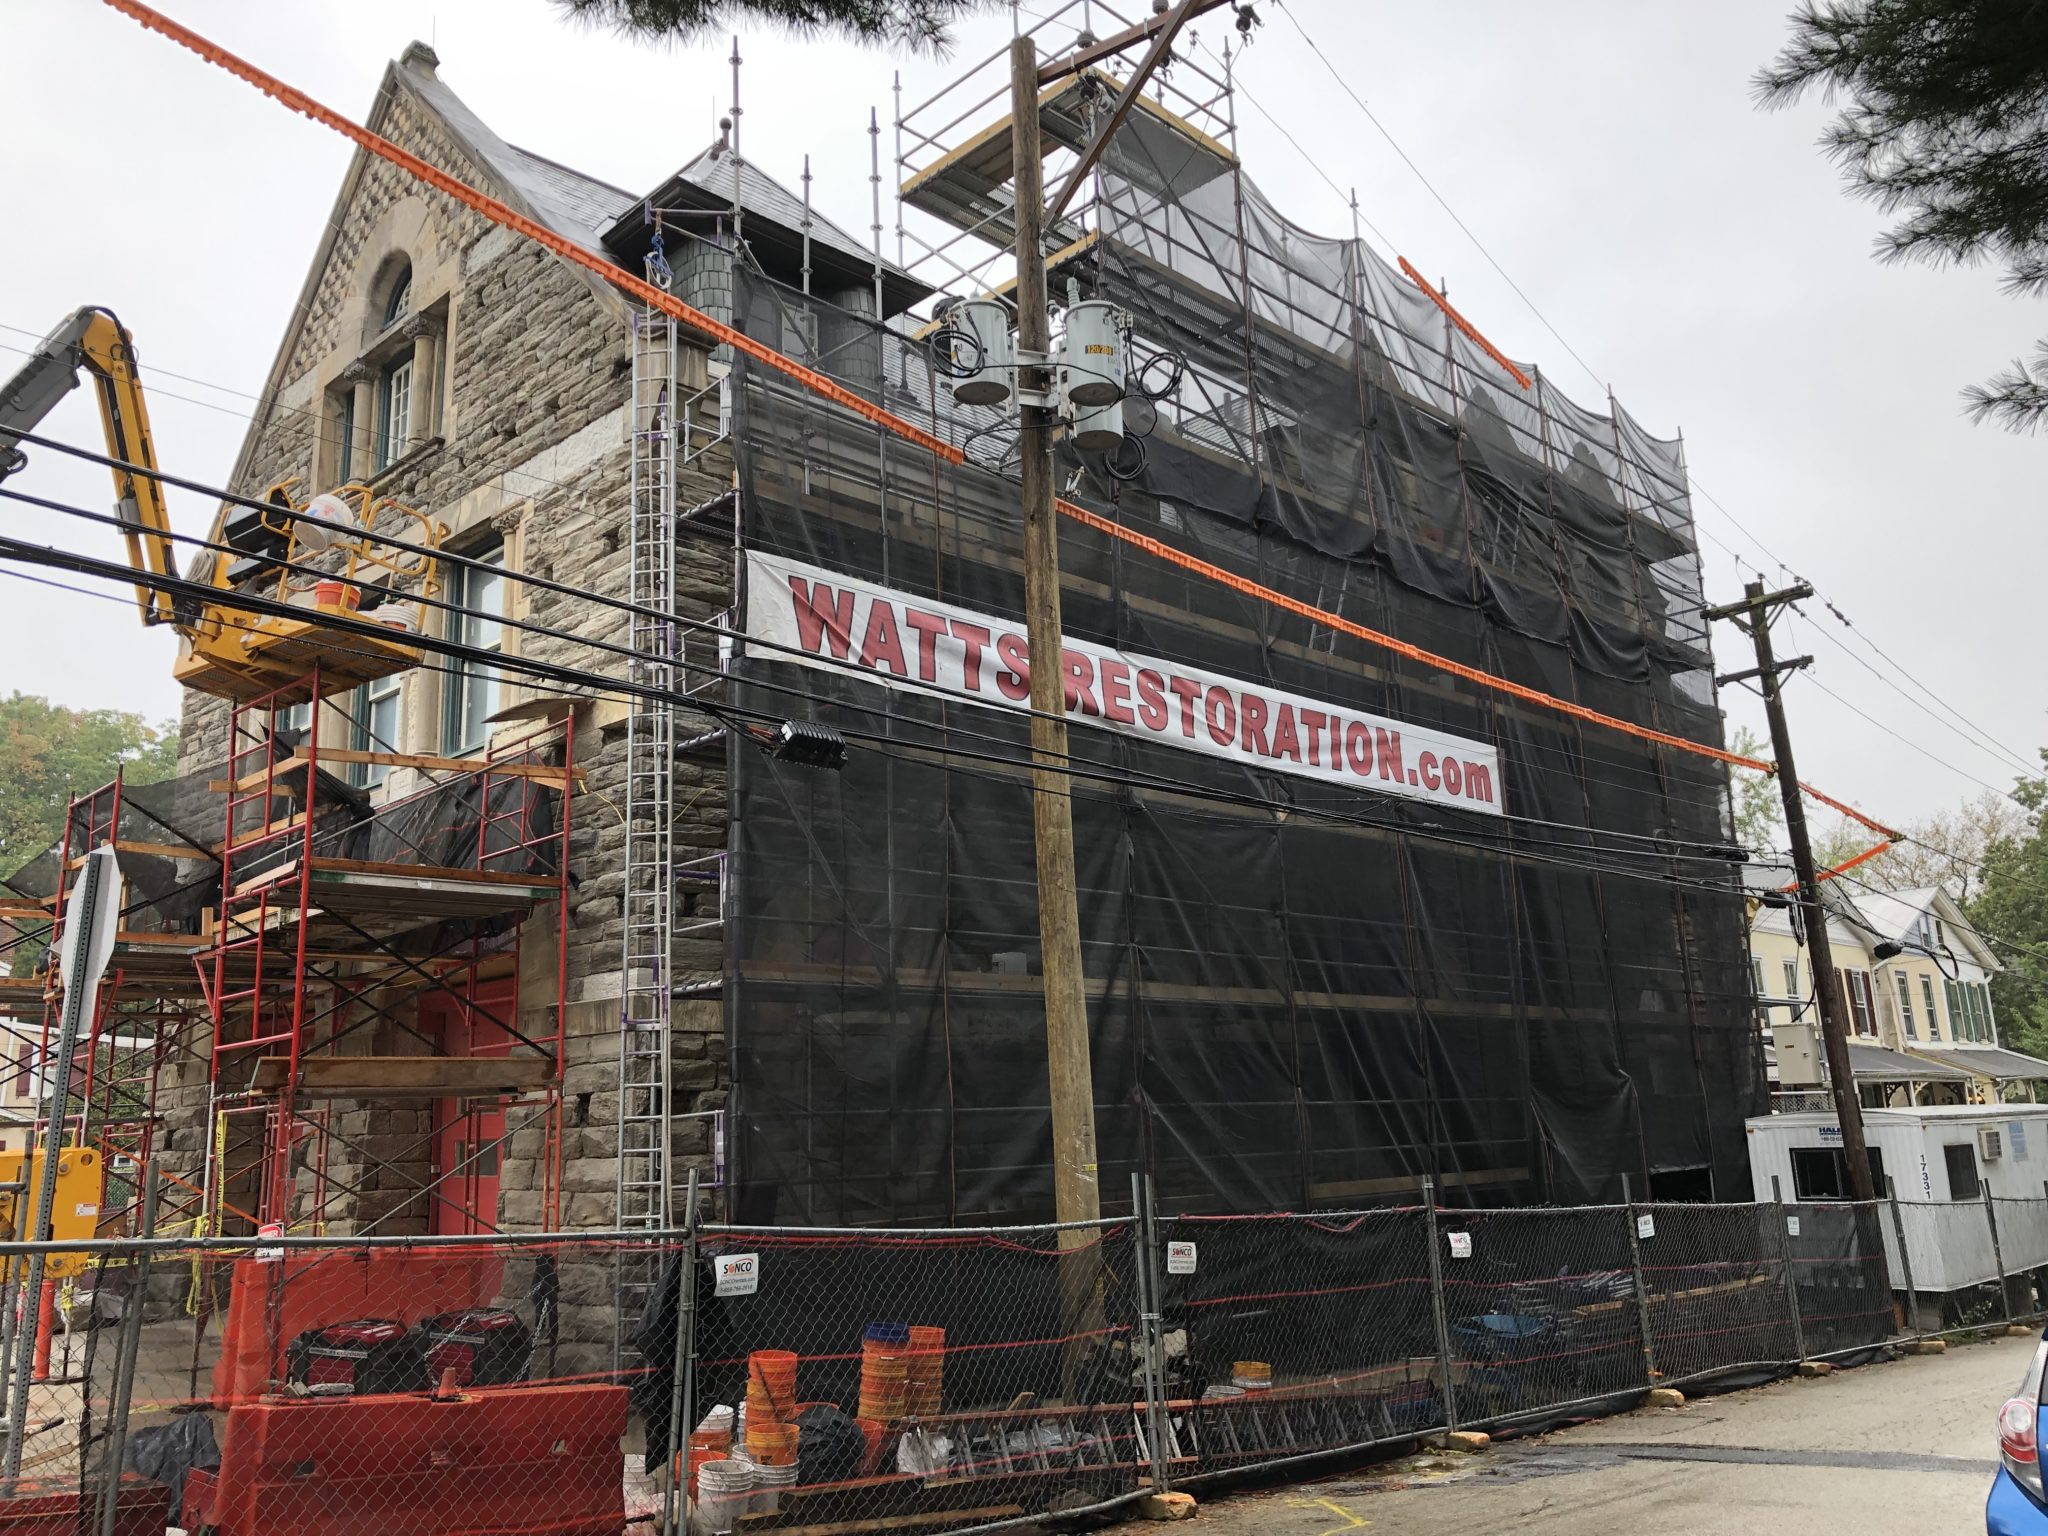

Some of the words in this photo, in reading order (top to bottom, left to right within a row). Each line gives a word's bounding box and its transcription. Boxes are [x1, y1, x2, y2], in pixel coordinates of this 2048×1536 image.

[788, 575, 1030, 701] WATTS
[1061, 647, 1494, 804] RESTORATION.com
[1920, 1154, 1930, 1200] 17331
[723, 1261, 752, 1274] SONCO
